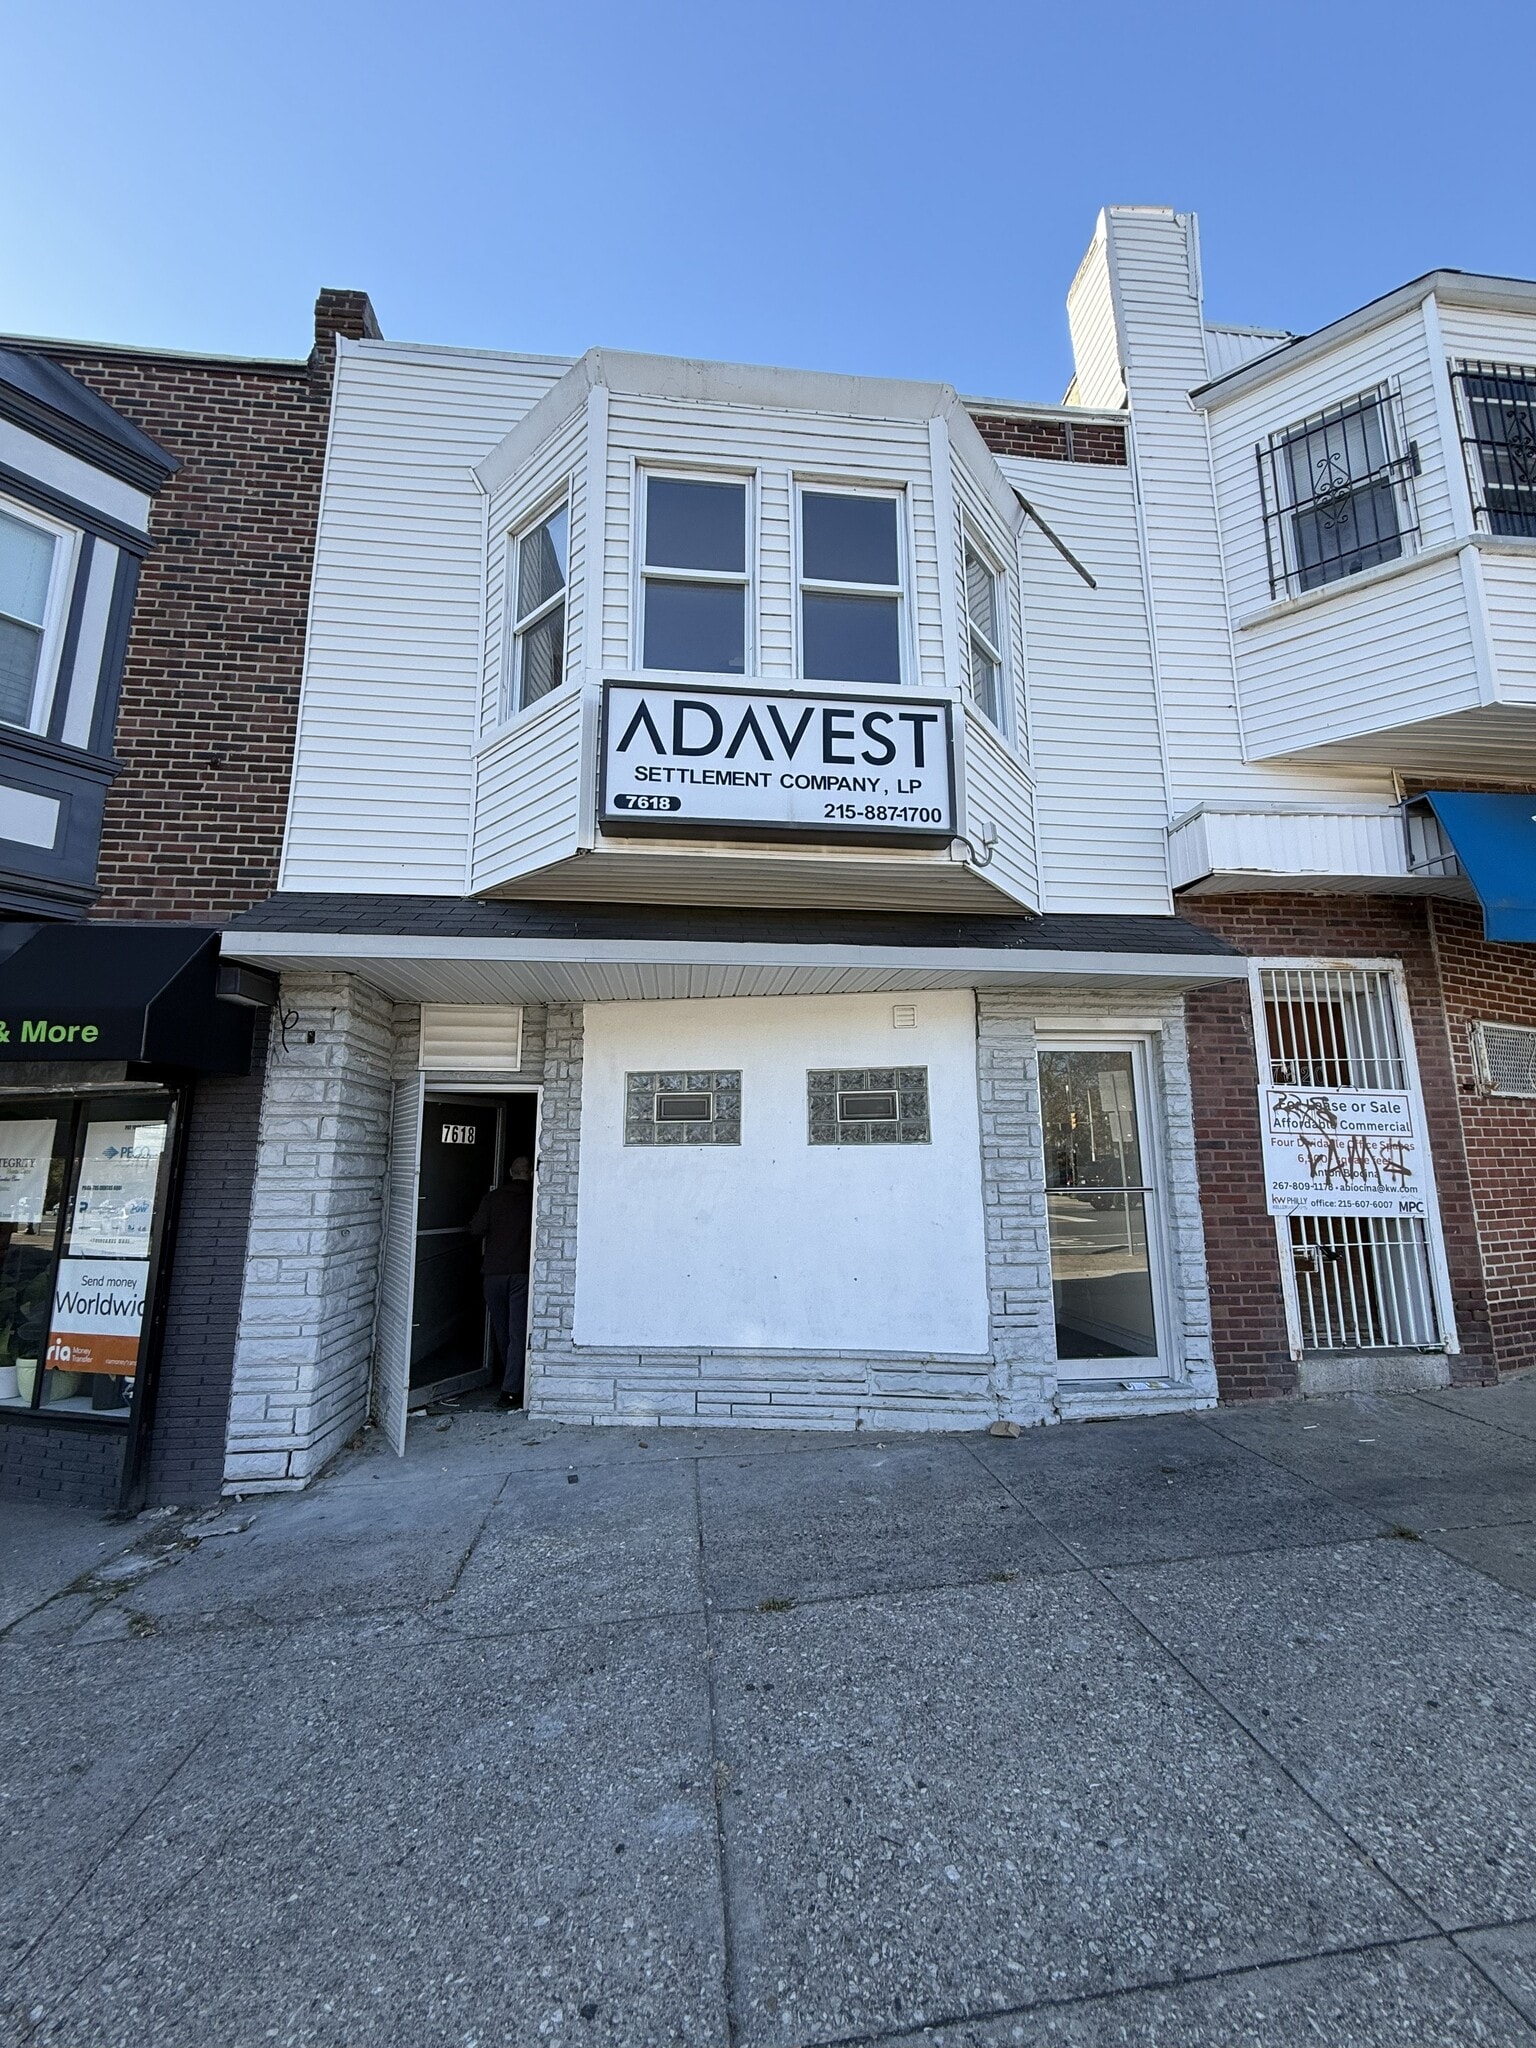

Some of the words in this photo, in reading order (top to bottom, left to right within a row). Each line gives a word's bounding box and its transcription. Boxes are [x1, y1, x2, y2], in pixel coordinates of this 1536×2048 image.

[616, 698, 938, 768] ADAVEST
[634, 766, 773, 789] SETTLEMENT
[897, 779, 922, 795] LP
[625, 795, 671, 810] 7618
[824, 803, 942, 823] 215-887-1700
[20, 1020, 99, 1043] More
[1351, 1103, 1366, 1112] or
[1370, 1101, 1401, 1114] Sale
[1340, 1120, 1410, 1132] Commercial
[444, 1125, 474, 1144] 7618
[1271, 1138, 1295, 1147] Four
[1272, 1181, 1334, 1192] 267-809-1178
[1340, 1183, 1418, 1194] abiocina@kw.com
[1310, 1199, 1337, 1208] office:
[1338, 1200, 1393, 1209] 215-607-6007
[1399, 1201, 1424, 1213] MPC
[81, 1275, 104, 1287] Send
[106, 1278, 138, 1290] money
[46, 1337, 71, 1362] ria
[72, 1346, 92, 1357] Money
[72, 1354, 94, 1364] Transfer
